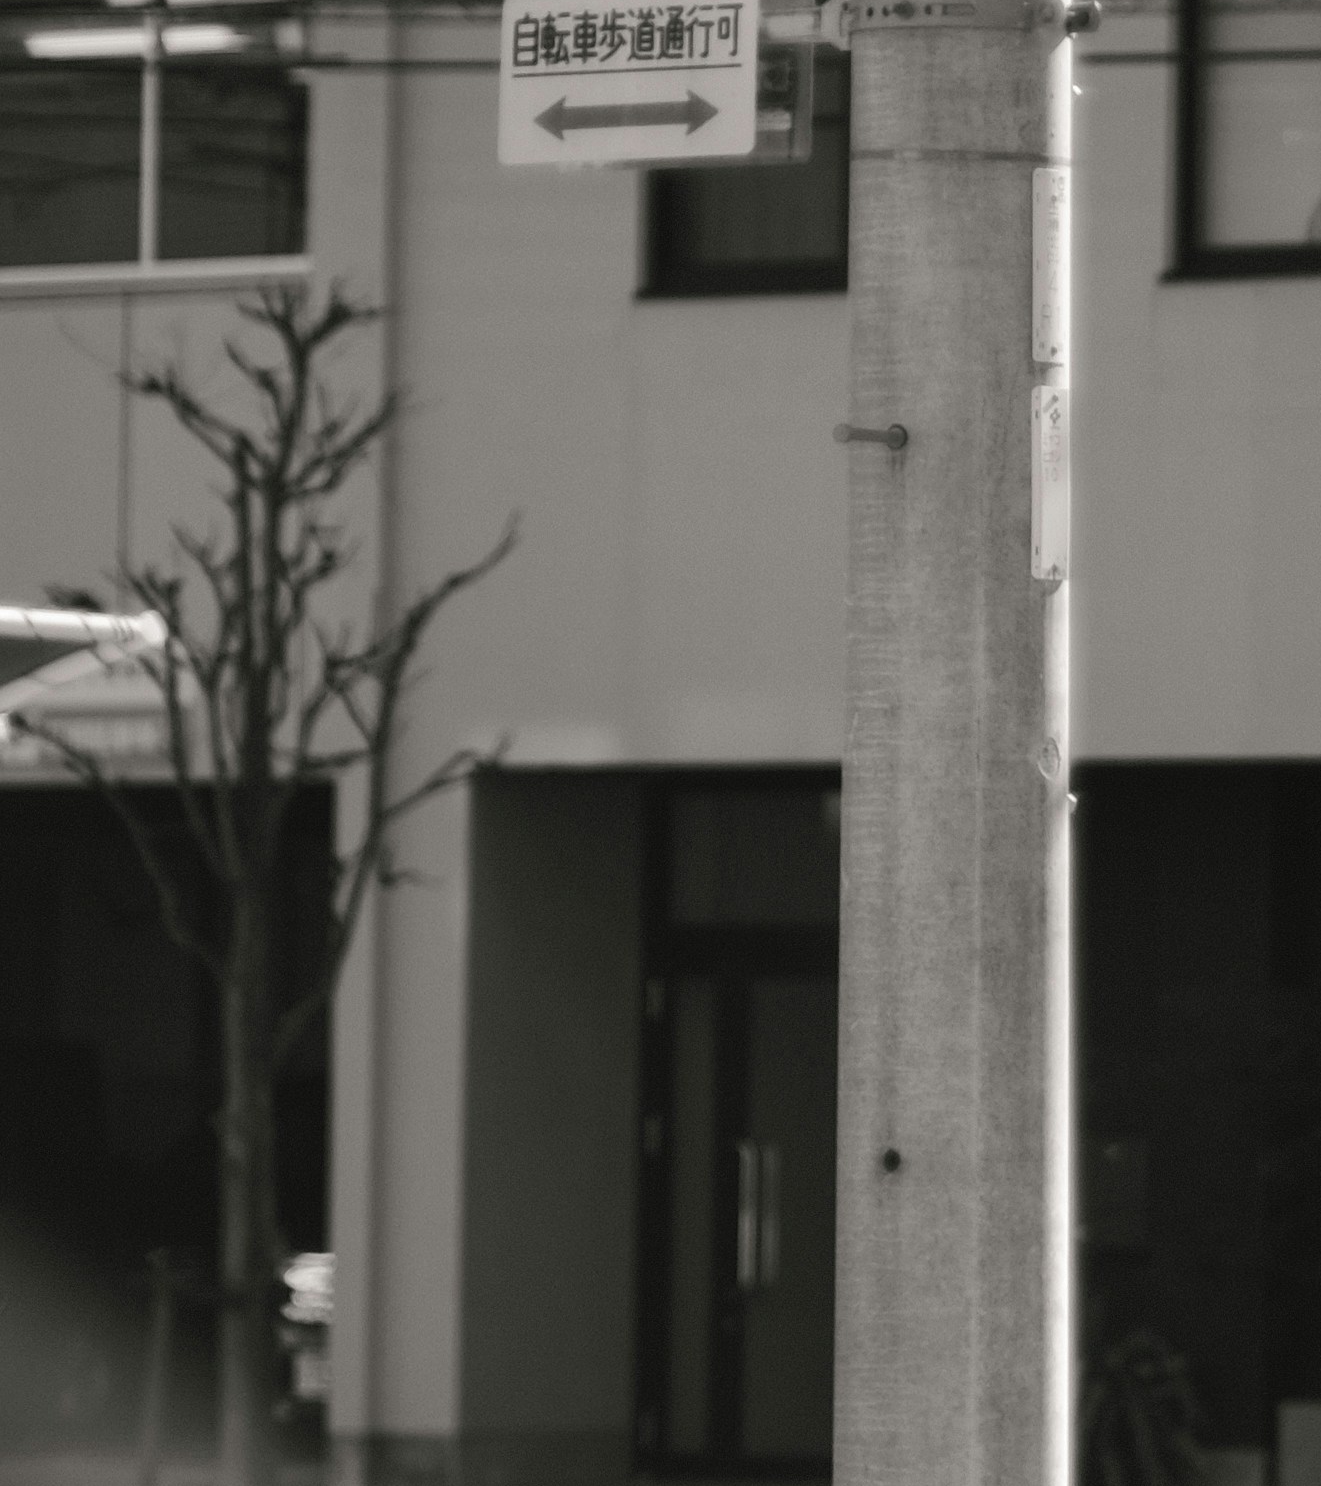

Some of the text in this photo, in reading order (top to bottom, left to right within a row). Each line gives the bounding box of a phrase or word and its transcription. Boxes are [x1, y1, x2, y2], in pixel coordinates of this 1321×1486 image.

[513, 3, 743, 67] 自転車歩道通行可
